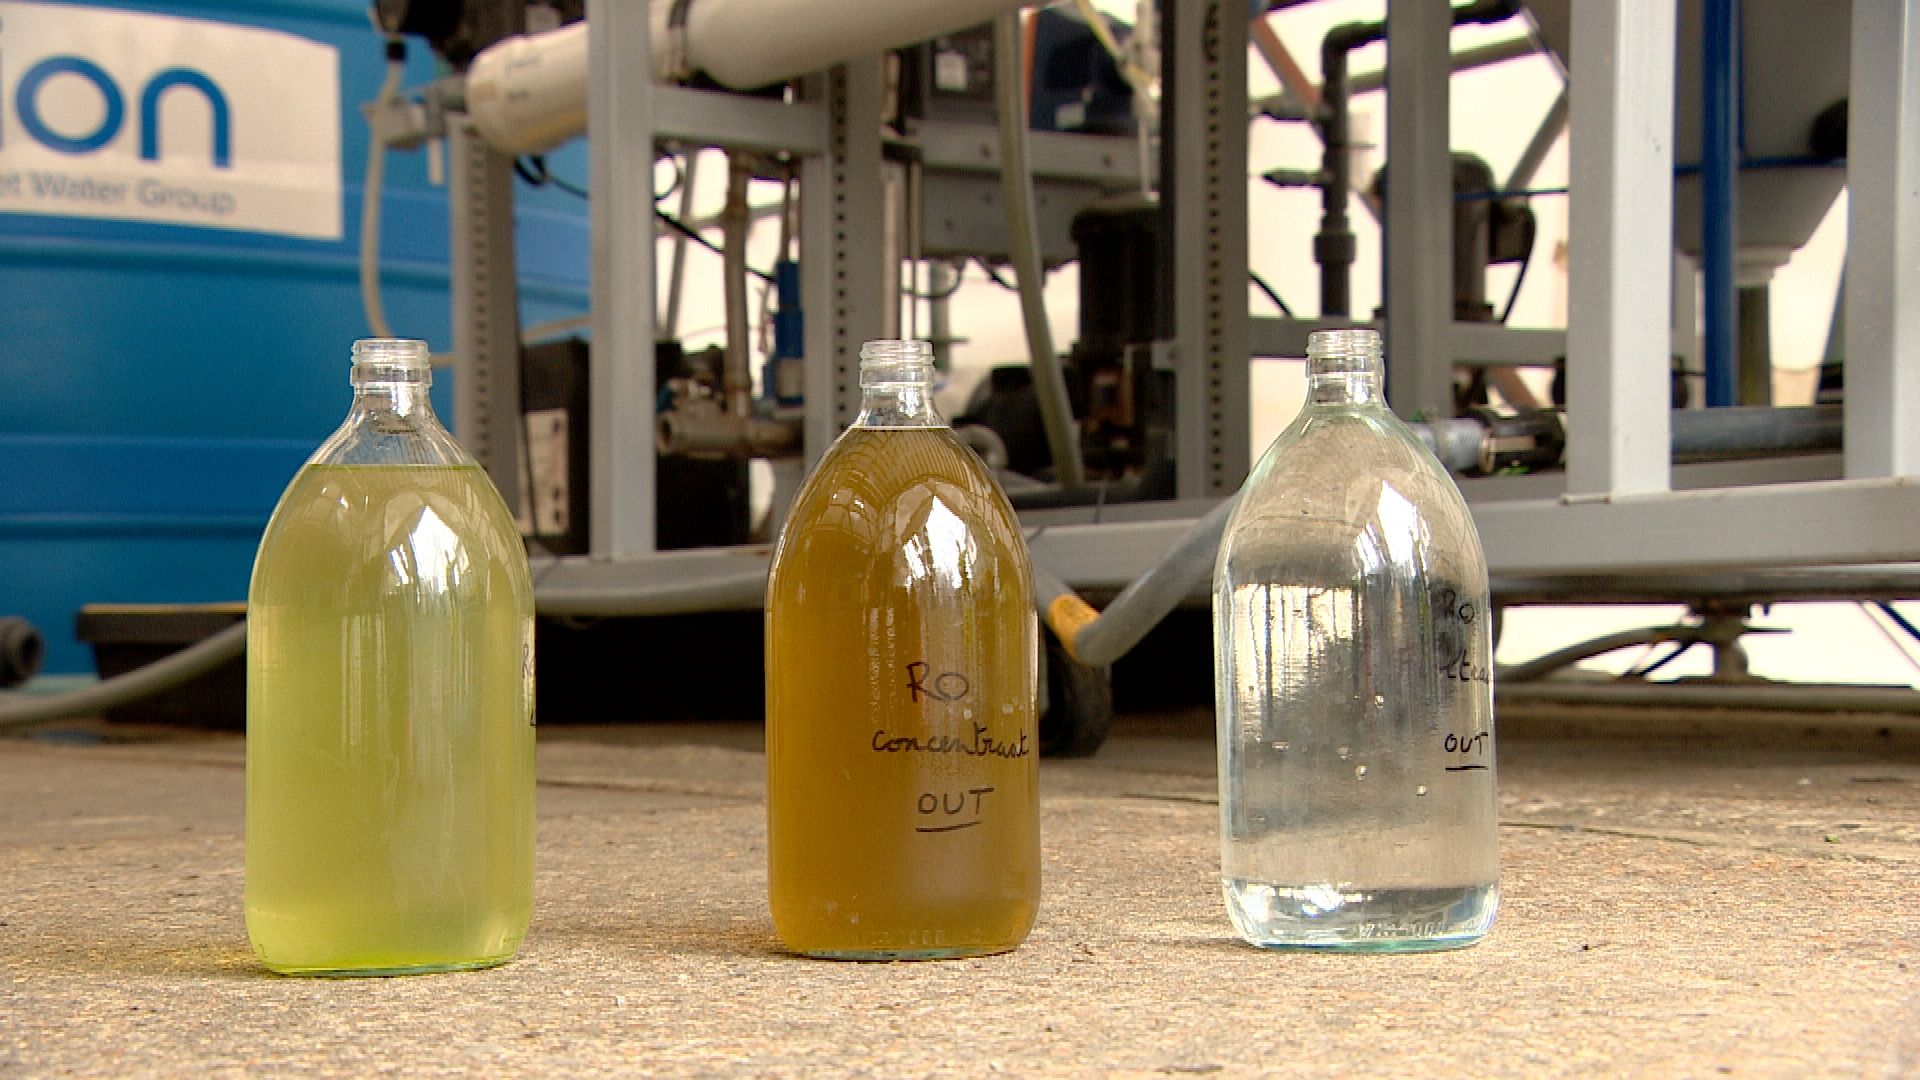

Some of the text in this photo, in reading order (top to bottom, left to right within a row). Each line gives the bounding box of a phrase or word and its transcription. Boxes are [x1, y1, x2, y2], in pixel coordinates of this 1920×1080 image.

[27, 172, 127, 205] Water
[137, 178, 237, 215] Group
[906, 661, 969, 703] RO
[1444, 733, 1489, 755] OUT
[917, 787, 995, 815] OUT
